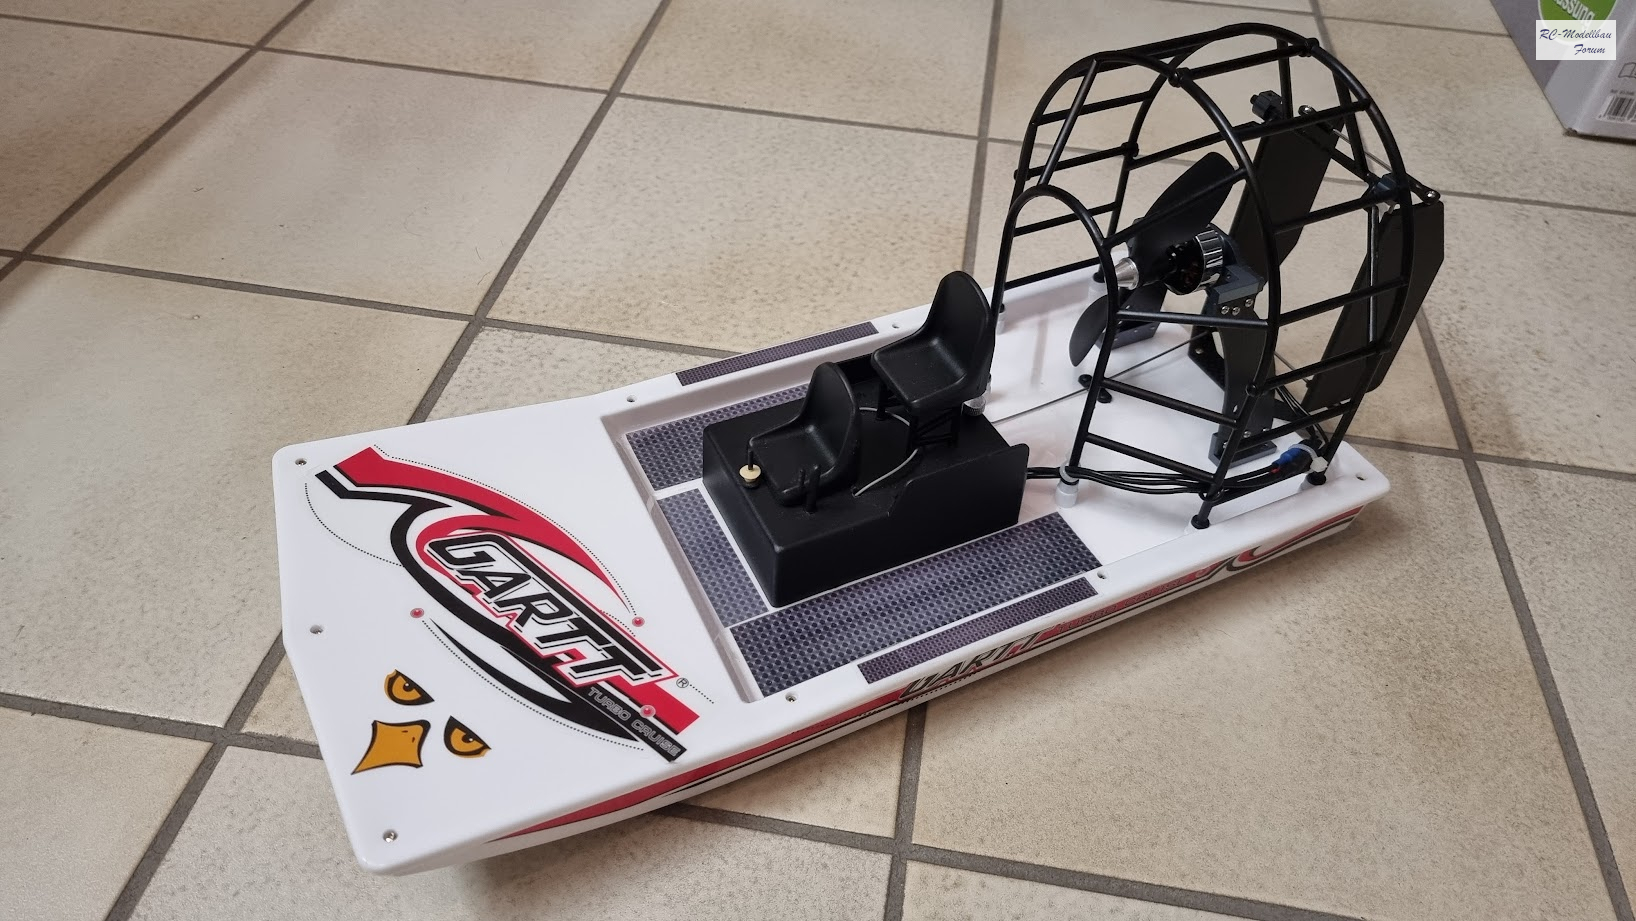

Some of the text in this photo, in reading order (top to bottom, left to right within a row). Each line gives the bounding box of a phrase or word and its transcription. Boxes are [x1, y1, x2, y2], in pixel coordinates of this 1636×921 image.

[427, 533, 664, 682] GARTT
[588, 686, 681, 757] TURBO CRUISE
